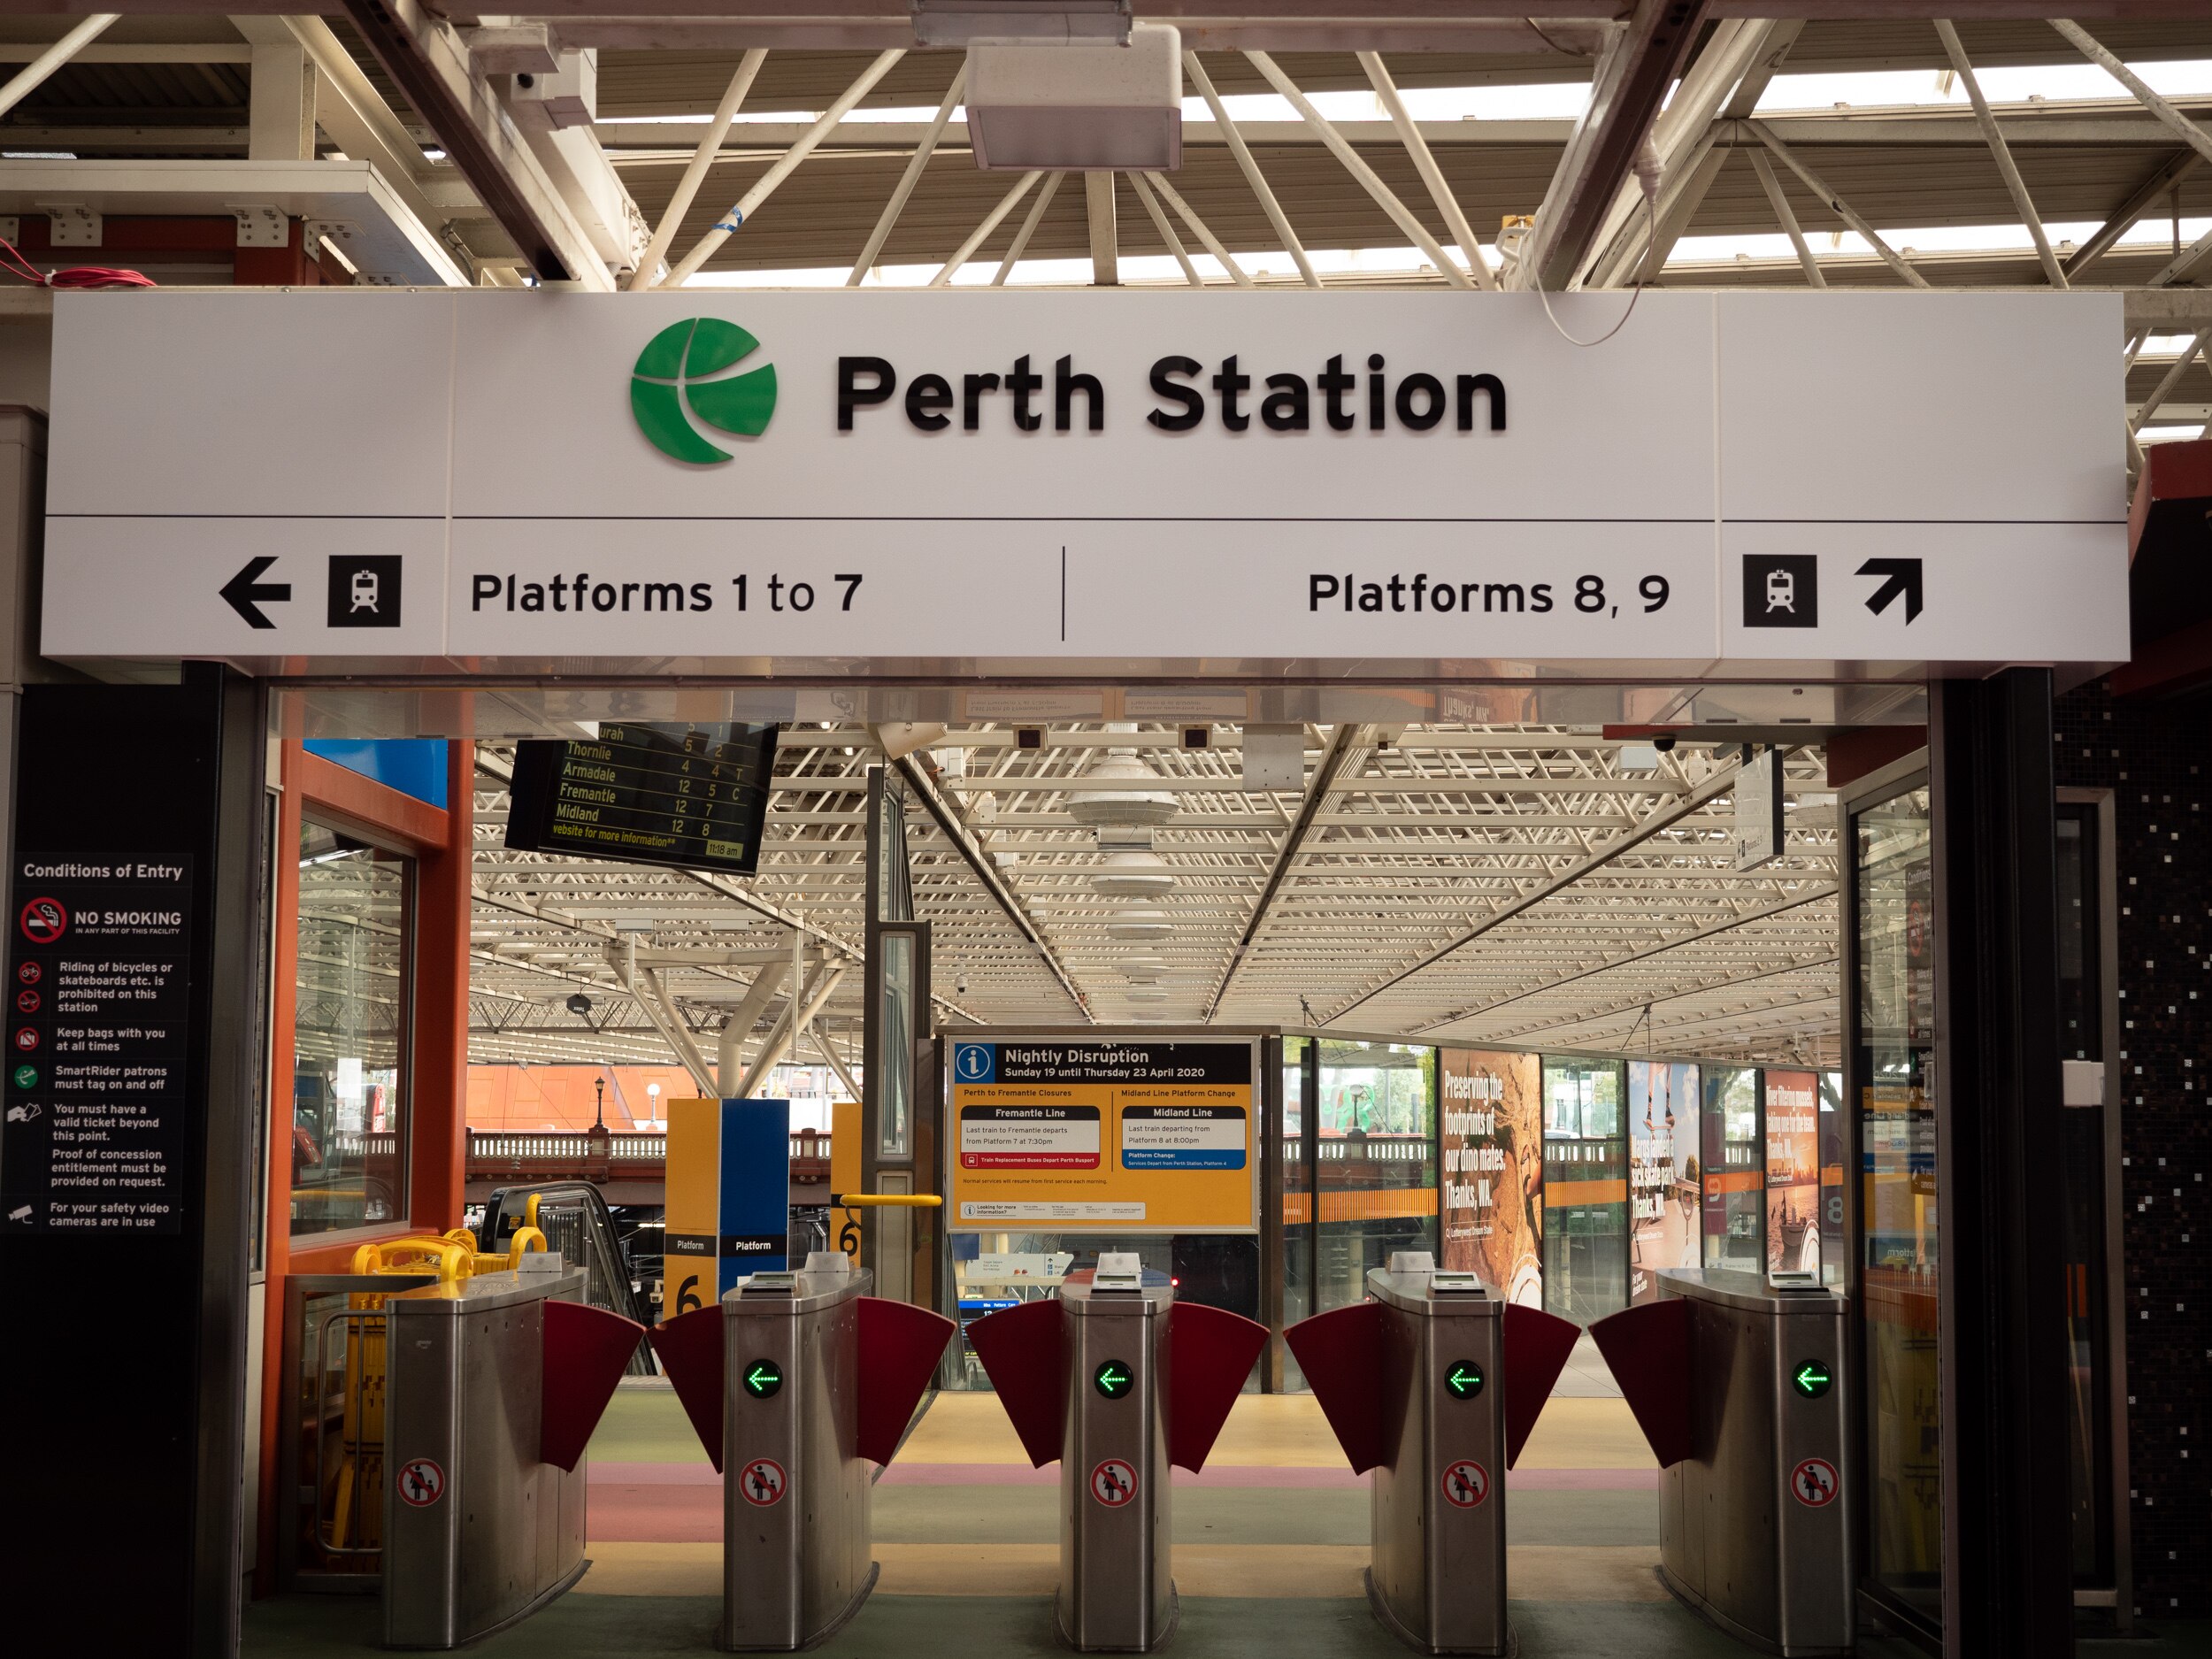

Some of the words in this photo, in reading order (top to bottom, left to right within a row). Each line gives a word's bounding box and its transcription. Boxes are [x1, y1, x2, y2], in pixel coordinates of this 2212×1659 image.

[838, 354, 1104, 432] Perth
[1147, 354, 1506, 432] Station
[472, 573, 712, 612] Platforms
[732, 574, 748, 611] 1
[768, 573, 815, 612] to
[834, 574, 863, 611] 7
[1310, 573, 1553, 612] Platforms
[1574, 575, 1618, 618] 8,
[1638, 575, 1670, 613] 9
[567, 741, 611, 761] Thornlie
[681, 760, 689, 772] 4
[711, 764, 719, 778] 4
[735, 769, 743, 780] T
[563, 762, 616, 782] Armadale
[679, 780, 690, 794] 12
[709, 784, 717, 797] 5
[732, 787, 740, 801] C
[559, 783, 616, 803] Fremantle
[675, 799, 687, 814] 12
[705, 803, 713, 817] 7
[557, 803, 600, 822] Midland
[672, 819, 684, 833] 12
[702, 824, 710, 837] 8
[584, 826, 597, 839] for
[598, 831, 619, 841] more
[709, 843, 725, 855] 11:18
[726, 847, 738, 856] am
[24, 864, 110, 877] Conditions
[115, 864, 132, 877] of
[137, 864, 182, 881] Entry
[75, 912, 98, 925] NO
[104, 912, 181, 926] SMOKING
[59, 962, 95, 973] Riding
[97, 962, 110, 972] of
[112, 962, 157, 974] bicycles
[59, 975, 127, 986] skateboards
[130, 977, 151, 986] etc.
[155, 976, 165, 986] is
[58, 988, 114, 1000] prohibited
[135, 989, 157, 999] this
[58, 1002, 98, 1011] station
[58, 1027, 85, 1039] Keep
[88, 1027, 114, 1039] bags
[118, 1028, 142, 1037] with
[145, 1030, 165, 1040] you
[56, 1041, 68, 1051] at
[72, 1041, 85, 1051] all
[88, 1041, 120, 1051] times
[1005, 1049, 1062, 1066] Nightly
[1068, 1049, 1149, 1066] Disruption
[56, 1065, 120, 1076] SmartRider
[124, 1067, 167, 1078] patrons
[1005, 1068, 1041, 1079] Sunday
[1044, 1068, 1056, 1077] 19
[1058, 1068, 1081, 1077] until
[1084, 1068, 1130, 1079] Thursday
[1133, 1068, 1147, 1077] 23
[1149, 1068, 1174, 1079] April
[1177, 1068, 1205, 1077] 2020
[55, 1079, 84, 1089] must
[88, 1079, 106, 1091] tag
[126, 1079, 147, 1089] and
[150, 1079, 165, 1089] off
[1445, 1070, 1489, 1105] Preserving
[1490, 1072, 1502, 1100] the
[54, 1104, 74, 1114] You
[78, 1105, 106, 1114] must
[110, 1104, 136, 1114] have
[995, 1109, 1043, 1118] Fremantle
[1045, 1109, 1065, 1118] Line
[1153, 1108, 1190, 1117] Midland
[1192, 1108, 1213, 1117] Line
[53, 1118, 80, 1127] valid
[83, 1118, 115, 1127] ticket
[119, 1118, 159, 1129] beyond
[1445, 1106, 1486, 1141] footprints
[1486, 1107, 1494, 1135] of
[53, 1131, 74, 1141] this
[78, 1132, 110, 1142] point.
[1173, 1136, 1200, 1145] 8:00pm
[52, 1149, 83, 1159] Proof
[86, 1149, 97, 1159] of
[100, 1150, 162, 1160] concession
[1445, 1148, 1459, 1171] our
[1461, 1142, 1478, 1171] dino
[1479, 1144, 1506, 1171] mates.
[51, 1163, 118, 1172] entitlement
[121, 1164, 150, 1173] must
[153, 1164, 166, 1173] be
[51, 1176, 99, 1187] provided
[102, 1178, 115, 1187] on
[119, 1178, 165, 1188] request.
[1446, 1179, 1477, 1210] Thanks,
[1479, 1179, 1493, 1207] WA.
[50, 1202, 69, 1212] For
[72, 1204, 96, 1214] your
[100, 1202, 136, 1214] safety
[140, 1203, 169, 1213] video
[50, 1217, 97, 1226] cameras
[100, 1217, 119, 1226] are
[122, 1217, 133, 1226] in
[135, 1217, 156, 1227] use
[678, 1240, 704, 1250] Platform
[840, 1222, 858, 1256] 6
[736, 1241, 771, 1250] Platform
[677, 1275, 702, 1313] 6
